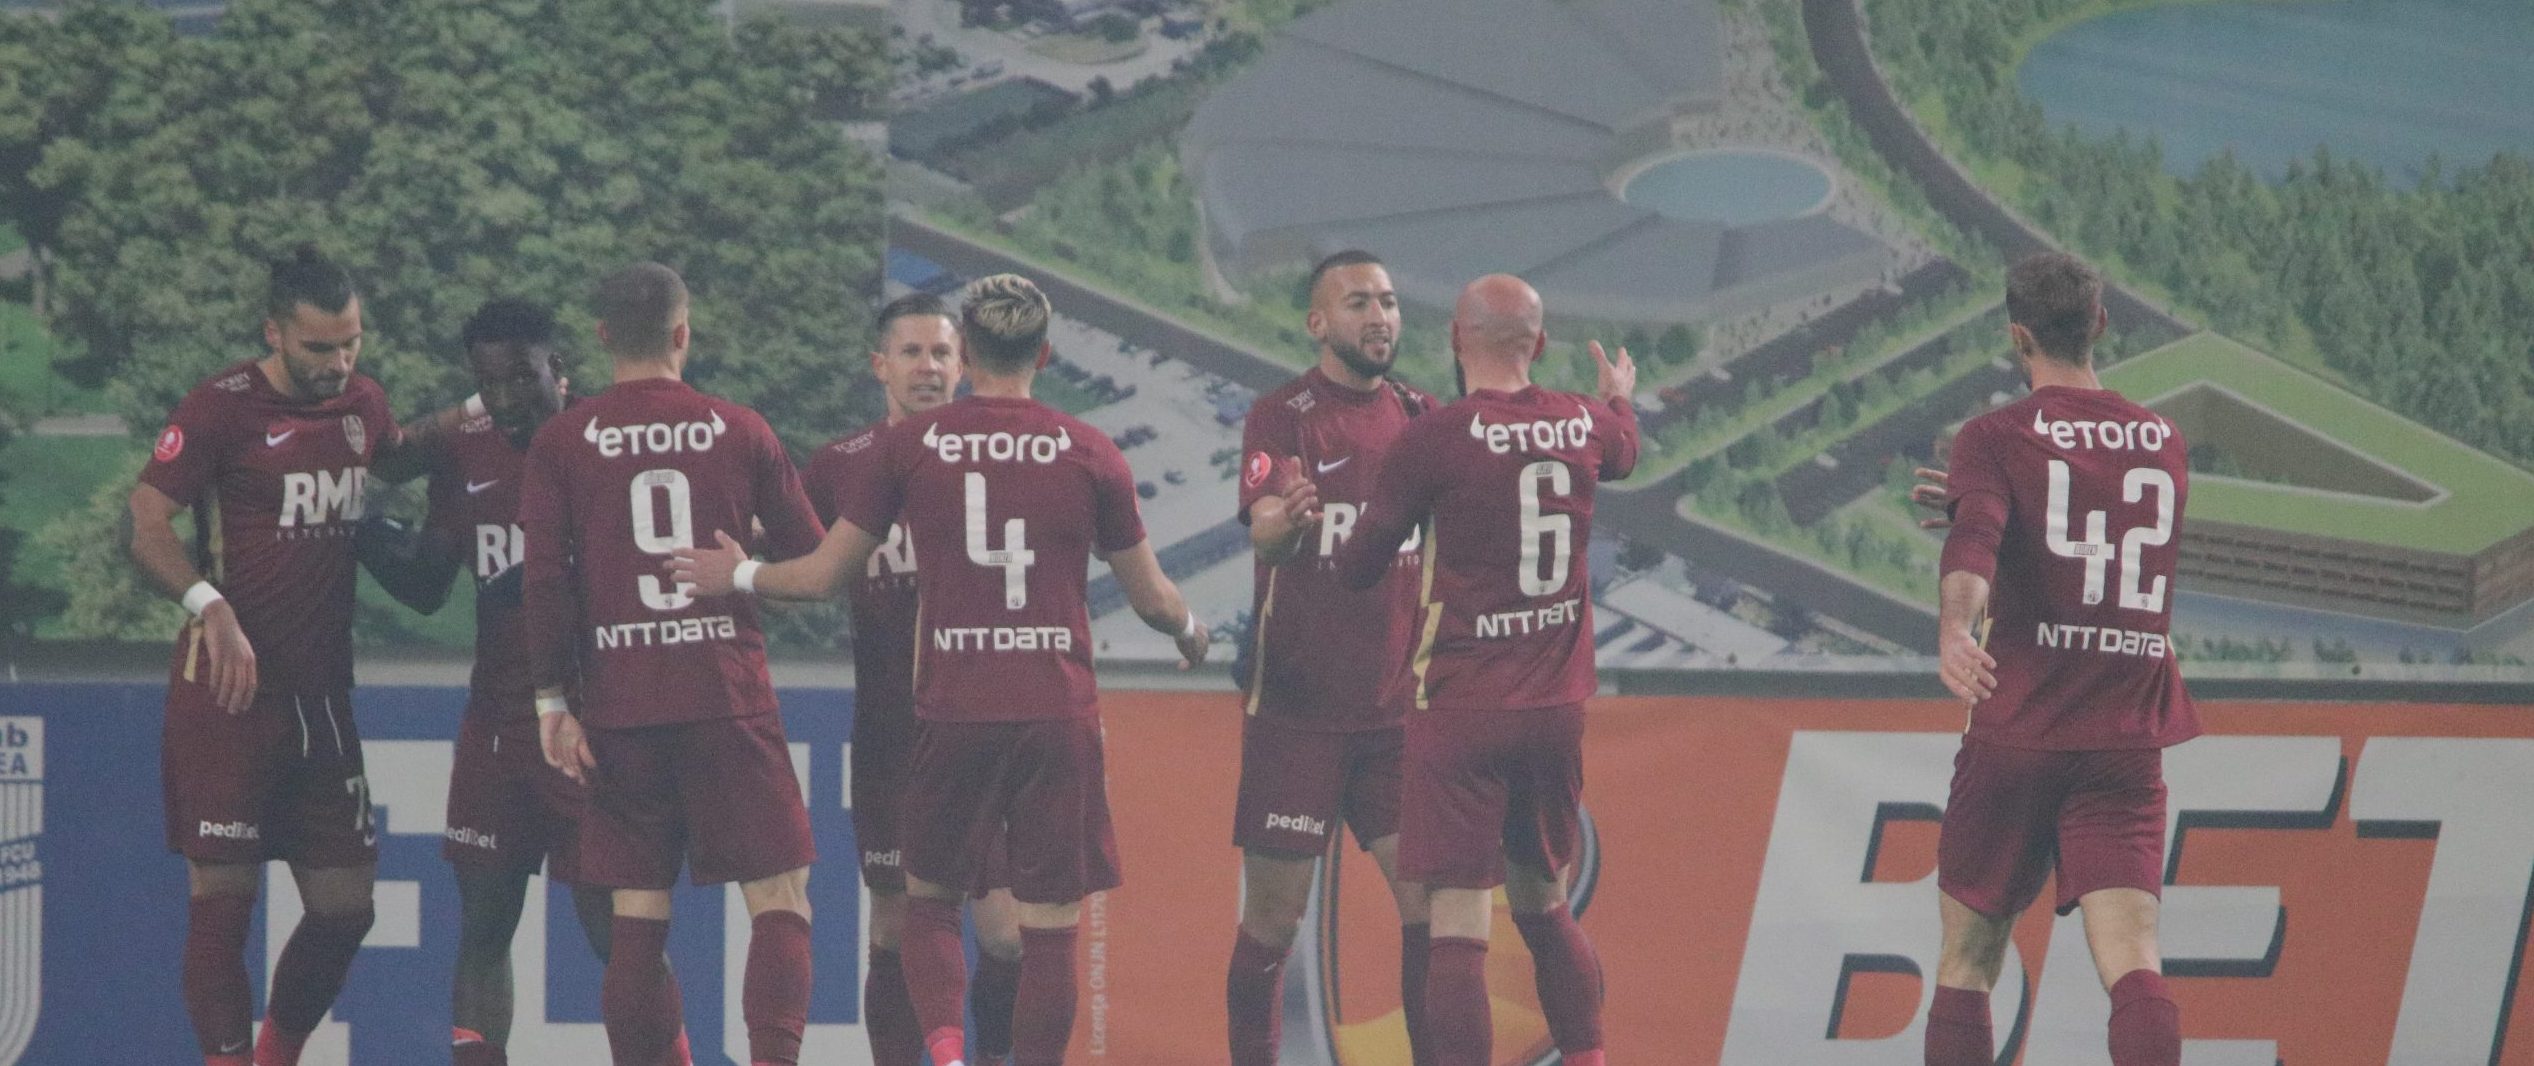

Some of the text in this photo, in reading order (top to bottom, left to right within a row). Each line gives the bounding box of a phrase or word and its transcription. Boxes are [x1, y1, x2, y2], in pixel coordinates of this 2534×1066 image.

[630, 468, 691, 610] 9
[965, 471, 1035, 610] 4
[1519, 460, 1572, 597] 6
[2046, 459, 2176, 613] 42
[596, 621, 657, 650] NTT
[934, 626, 990, 651] NTT
[1476, 610, 1534, 638] NTT
[2037, 622, 2097, 650] NTT
[447, 826, 498, 849] editel
